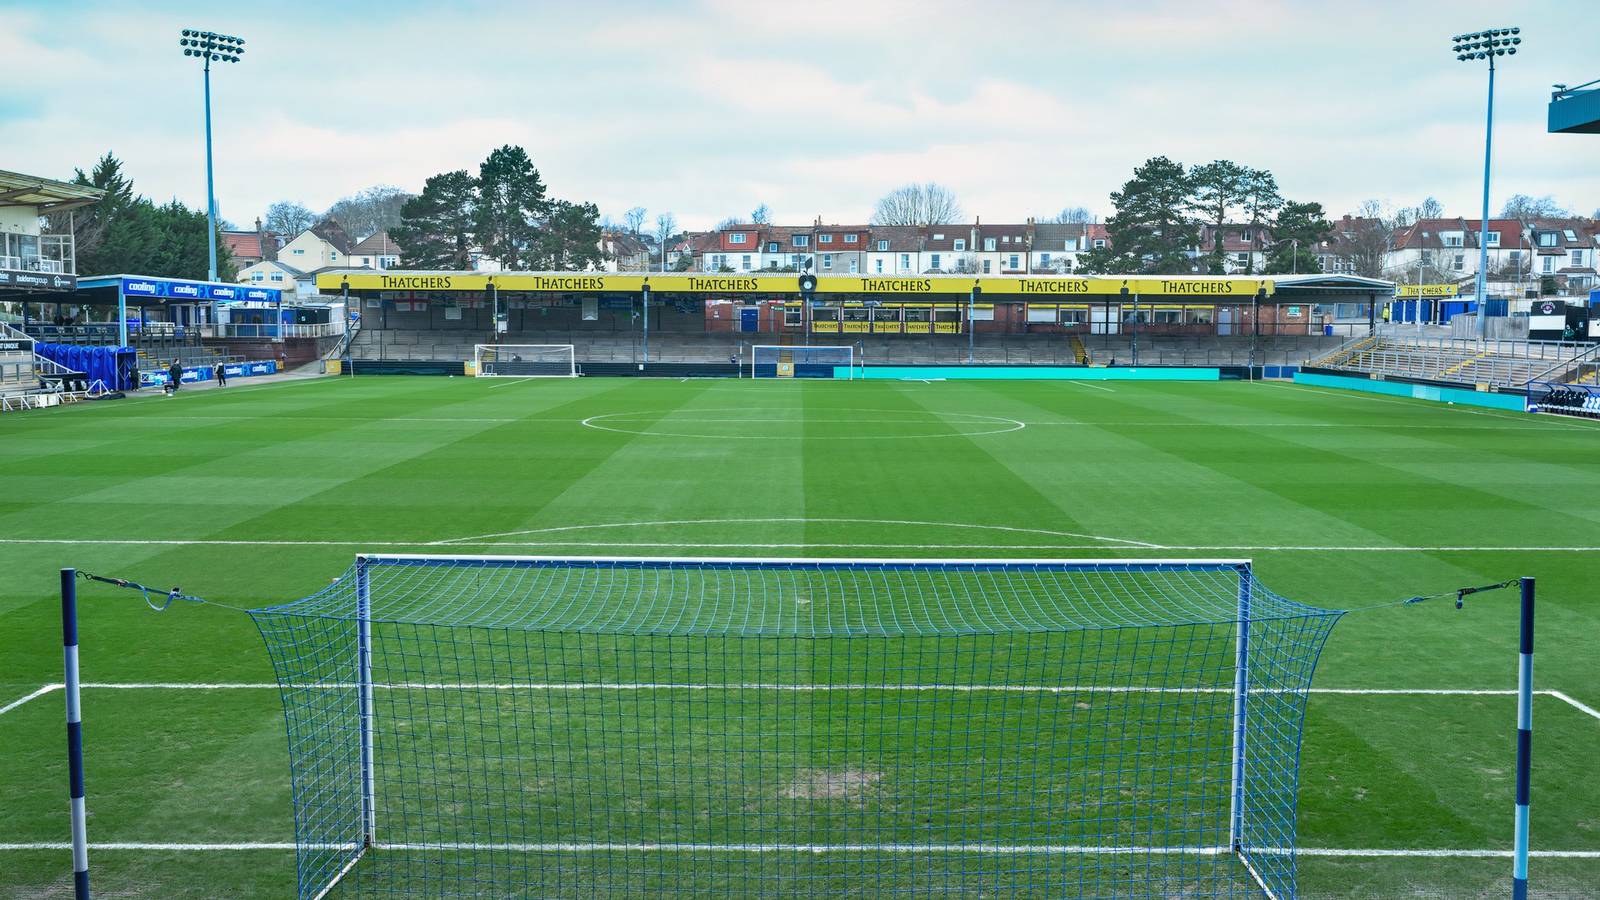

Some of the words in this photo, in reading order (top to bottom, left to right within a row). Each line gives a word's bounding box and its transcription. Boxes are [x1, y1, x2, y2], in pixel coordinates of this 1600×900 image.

[381, 275, 451, 289] THATCHERS
[534, 276, 604, 290] THATCHERS
[688, 277, 758, 291] THATCHERS
[861, 278, 931, 292] THATCHERS
[1019, 279, 1089, 293] THATCHERS
[1161, 279, 1232, 293] THATCHERS
[1407, 287, 1443, 295] THACHERS
